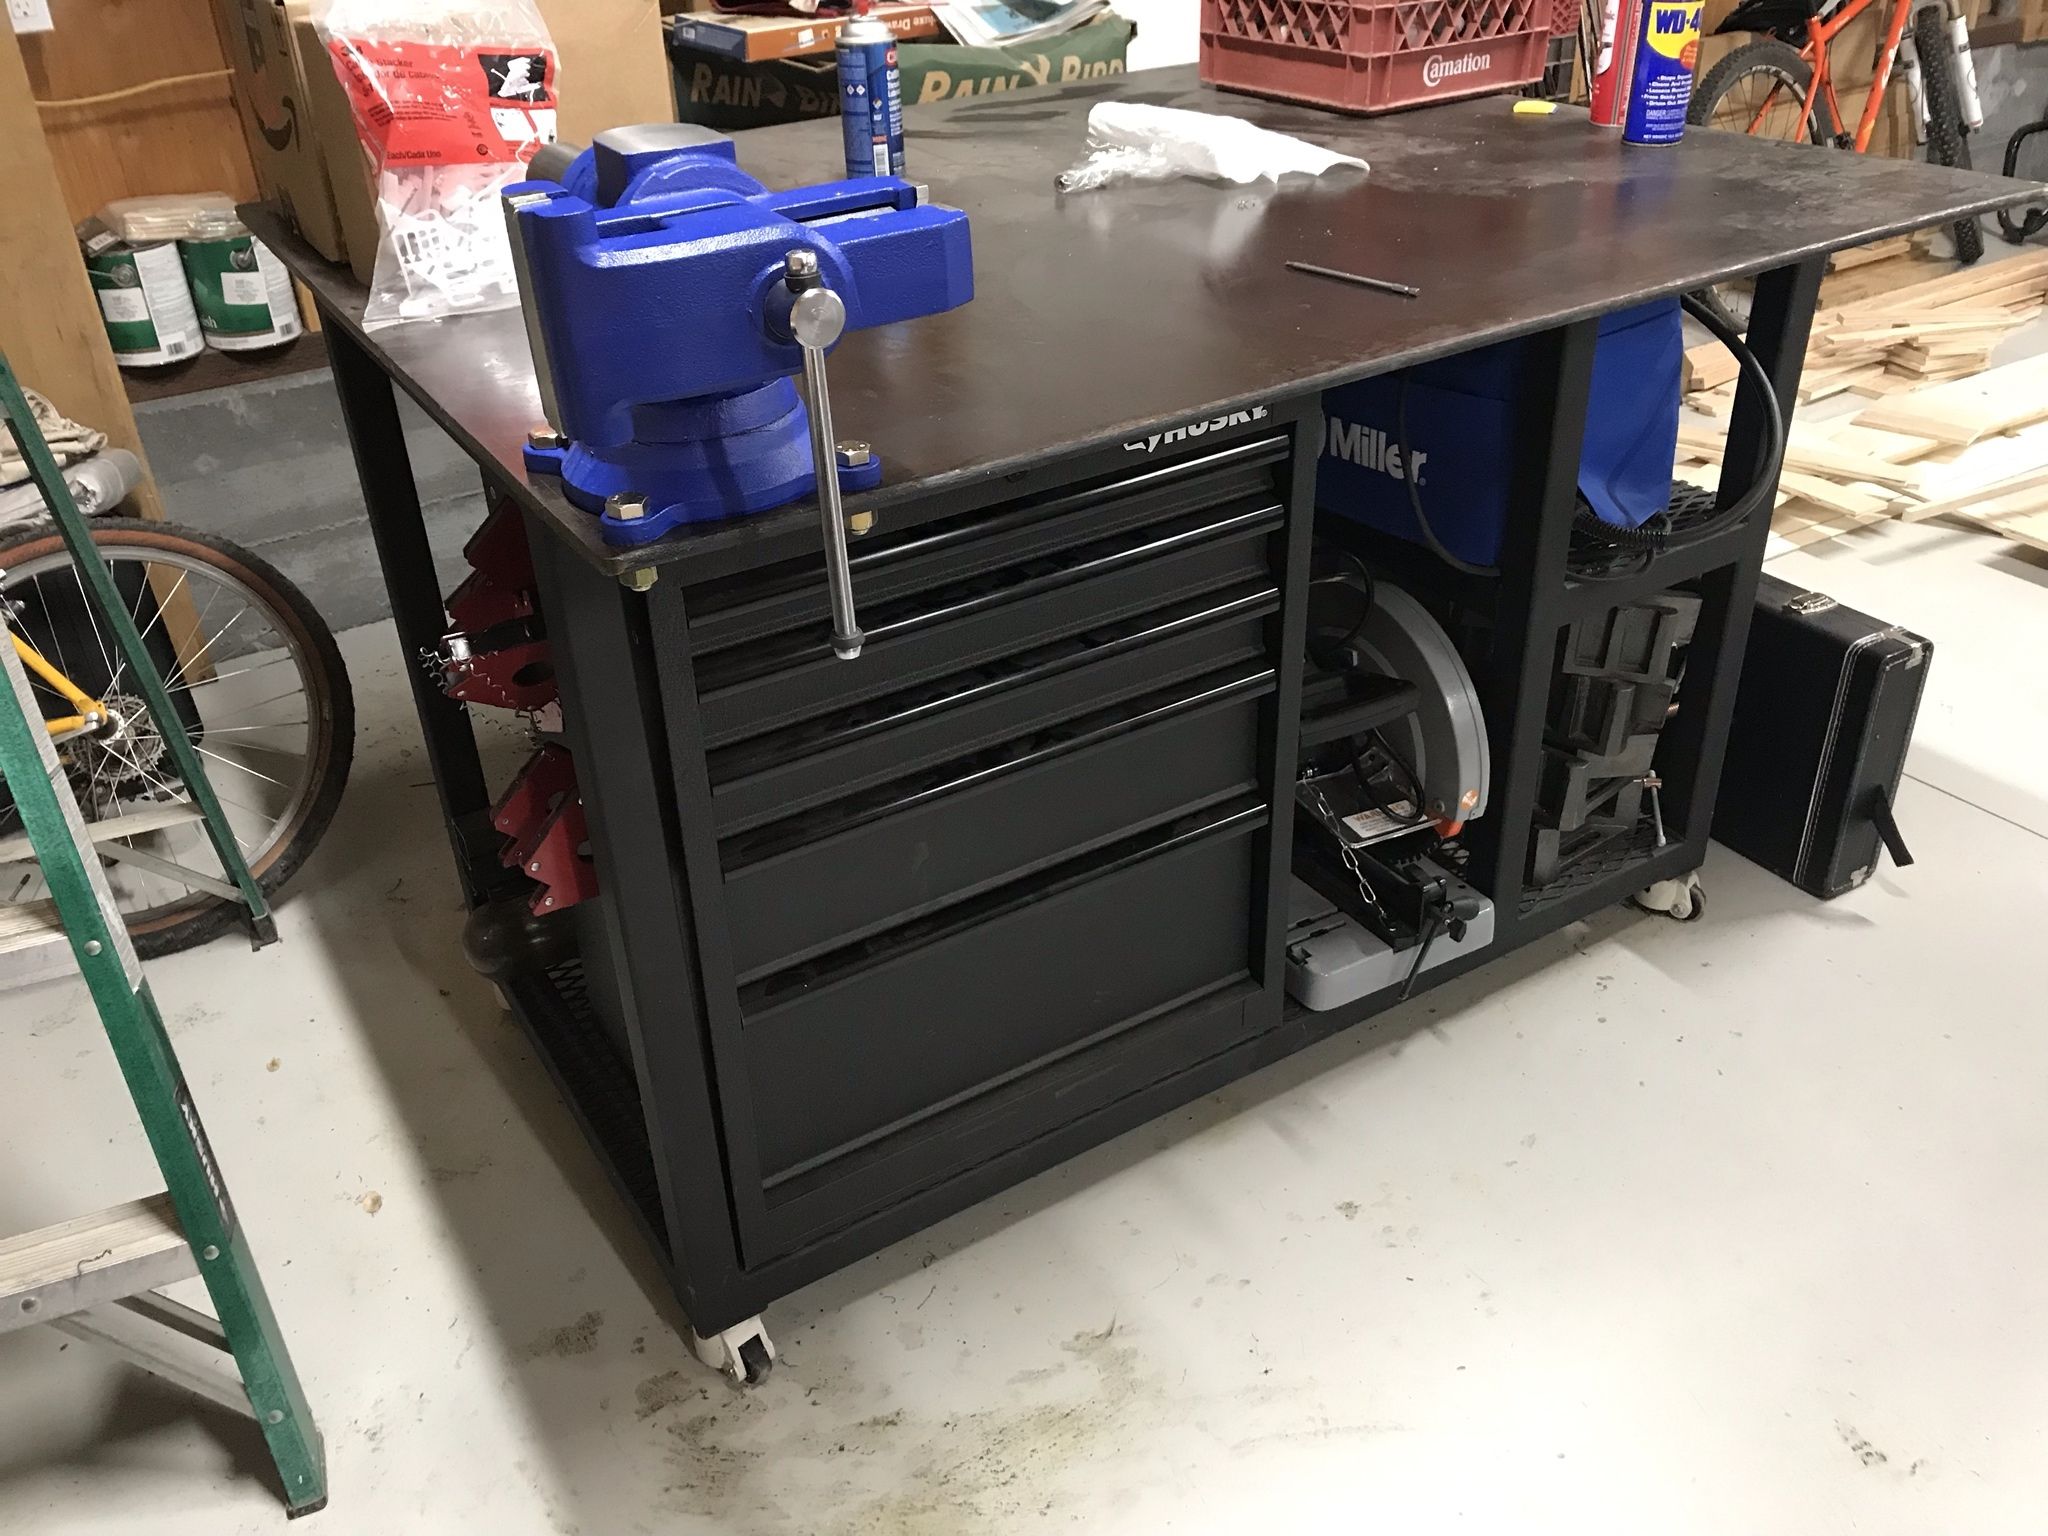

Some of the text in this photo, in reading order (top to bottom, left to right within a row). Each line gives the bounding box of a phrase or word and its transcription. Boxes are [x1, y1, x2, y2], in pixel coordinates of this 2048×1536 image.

[1656, 8, 1702, 34] WD-4
[690, 62, 841, 114] RAIN BIR
[1422, 52, 1491, 87] Carnation
[1329, 416, 1428, 484] Miller
